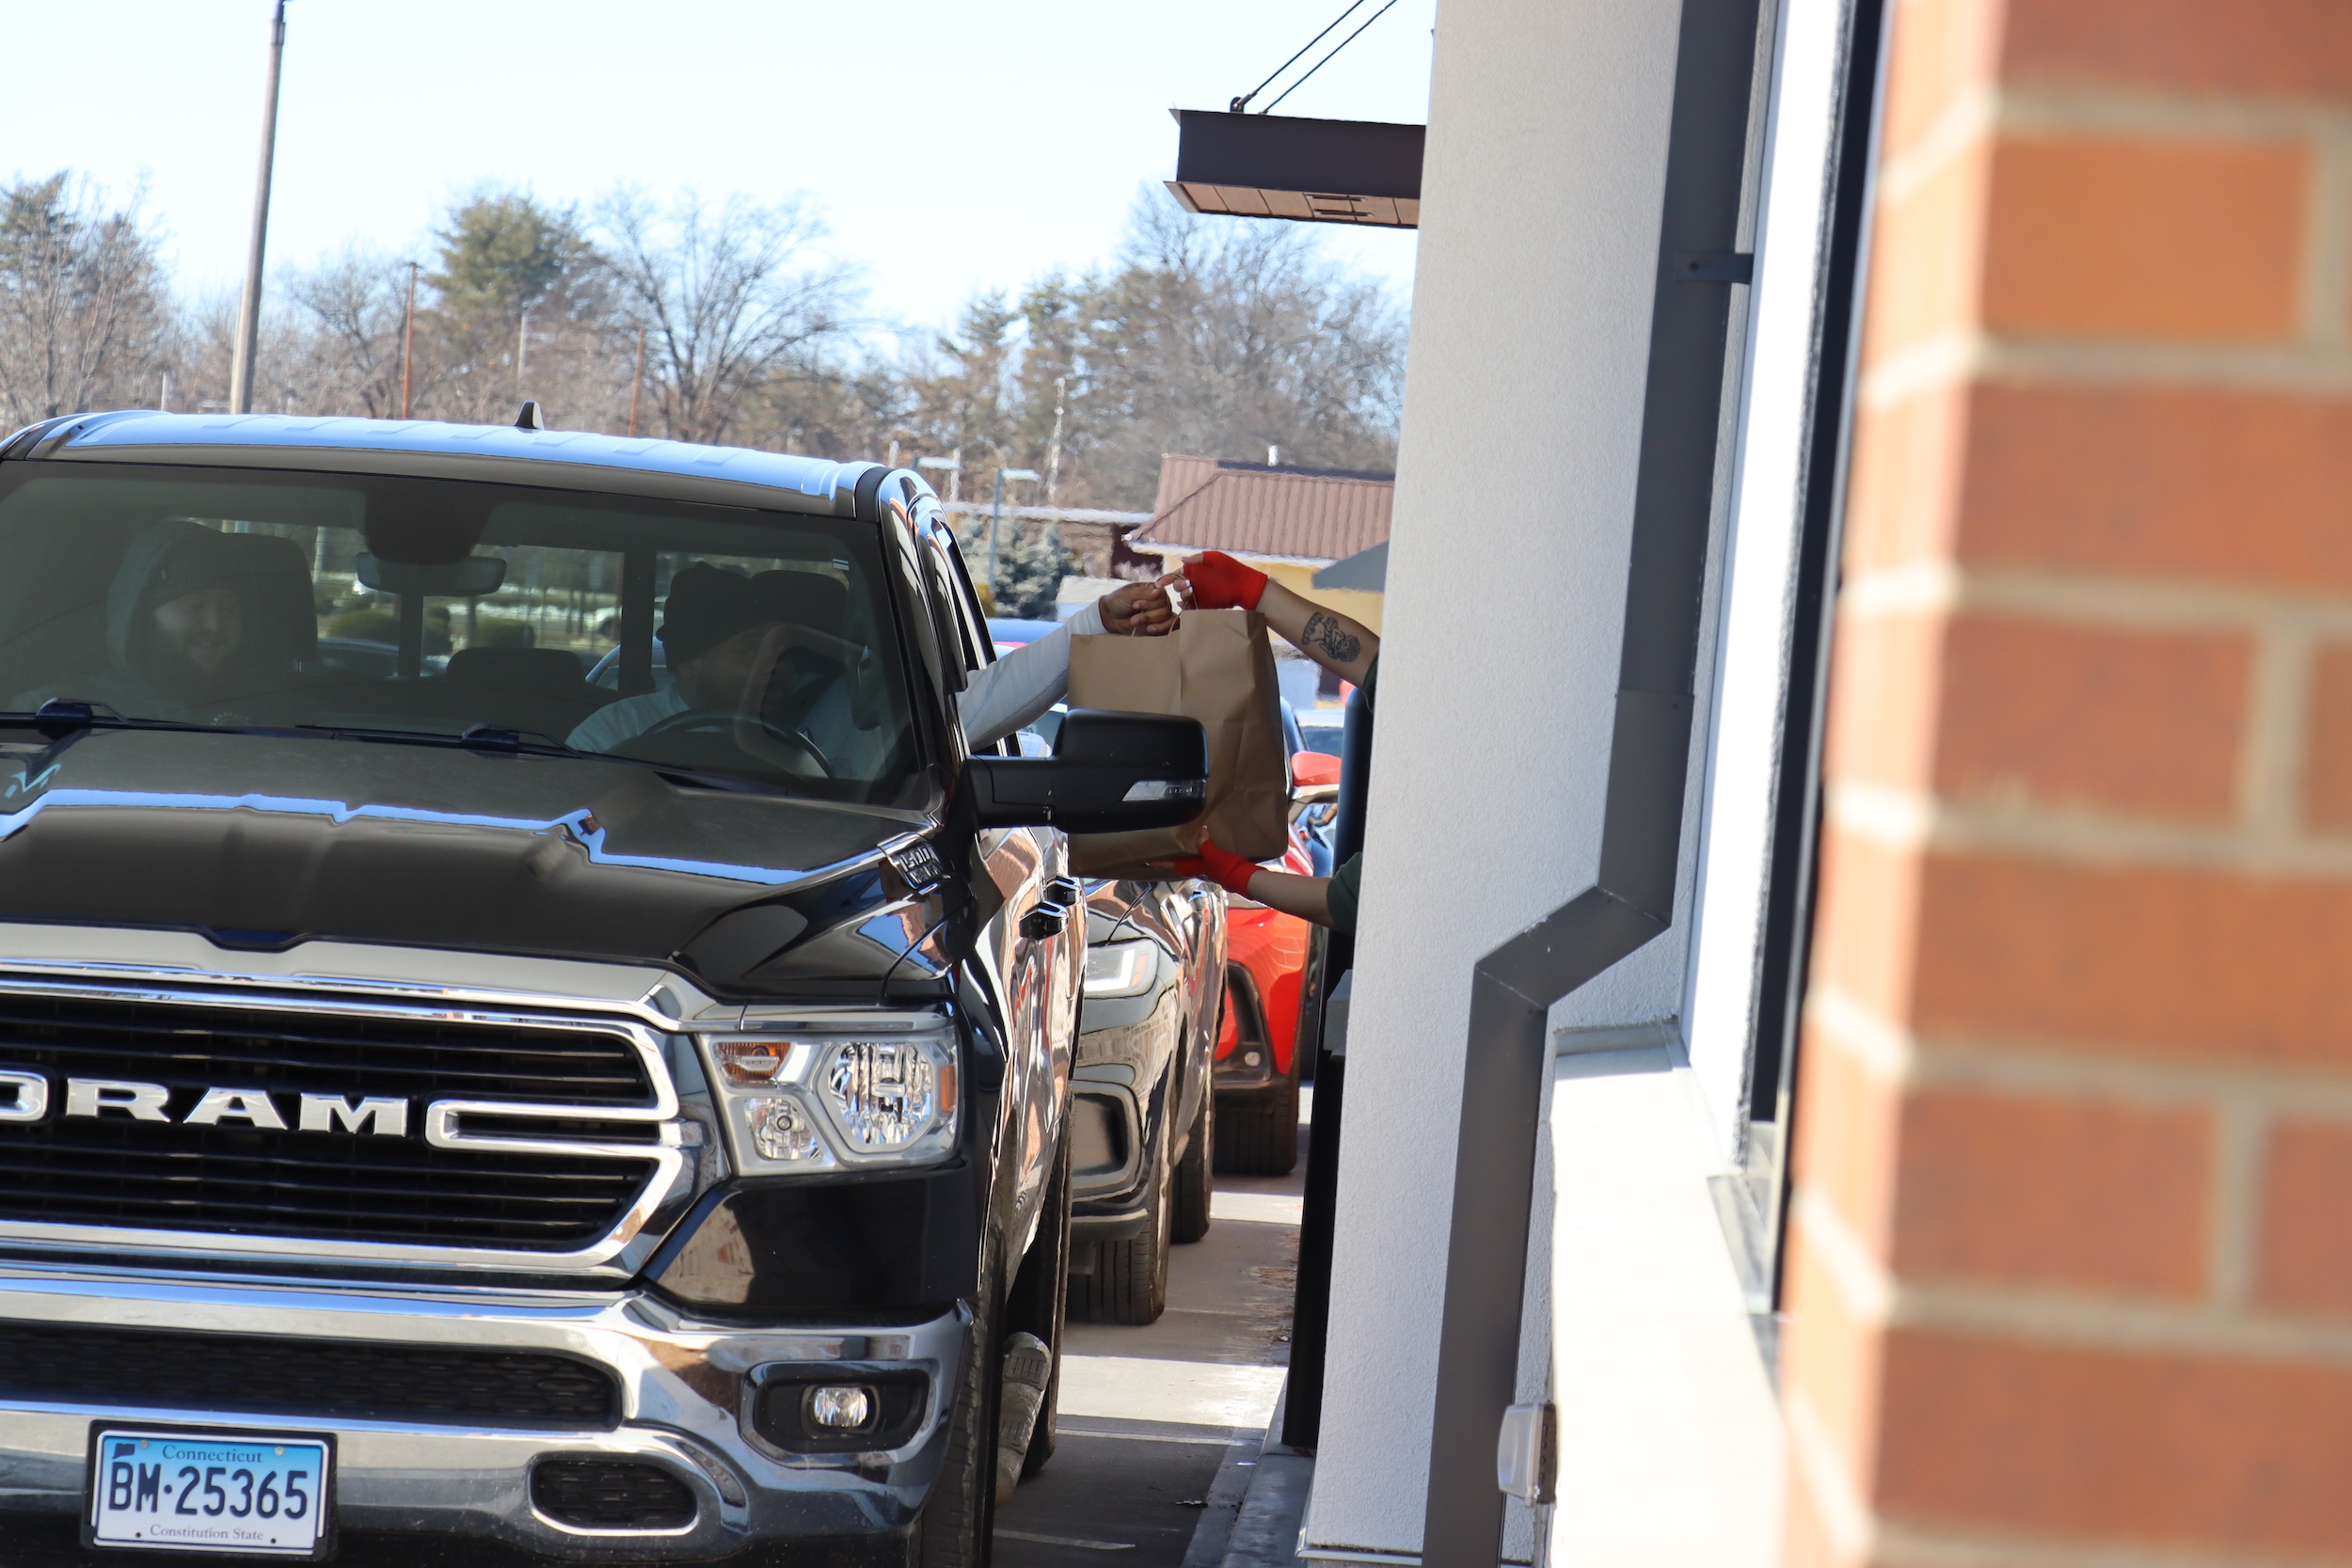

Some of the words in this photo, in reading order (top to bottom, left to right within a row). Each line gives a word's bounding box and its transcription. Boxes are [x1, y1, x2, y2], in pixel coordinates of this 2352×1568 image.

[66, 1077, 408, 1136] RAM
[162, 1444, 262, 1463] Connecticut
[150, 1524, 229, 1539] Constitution
[232, 1528, 263, 1541] State
